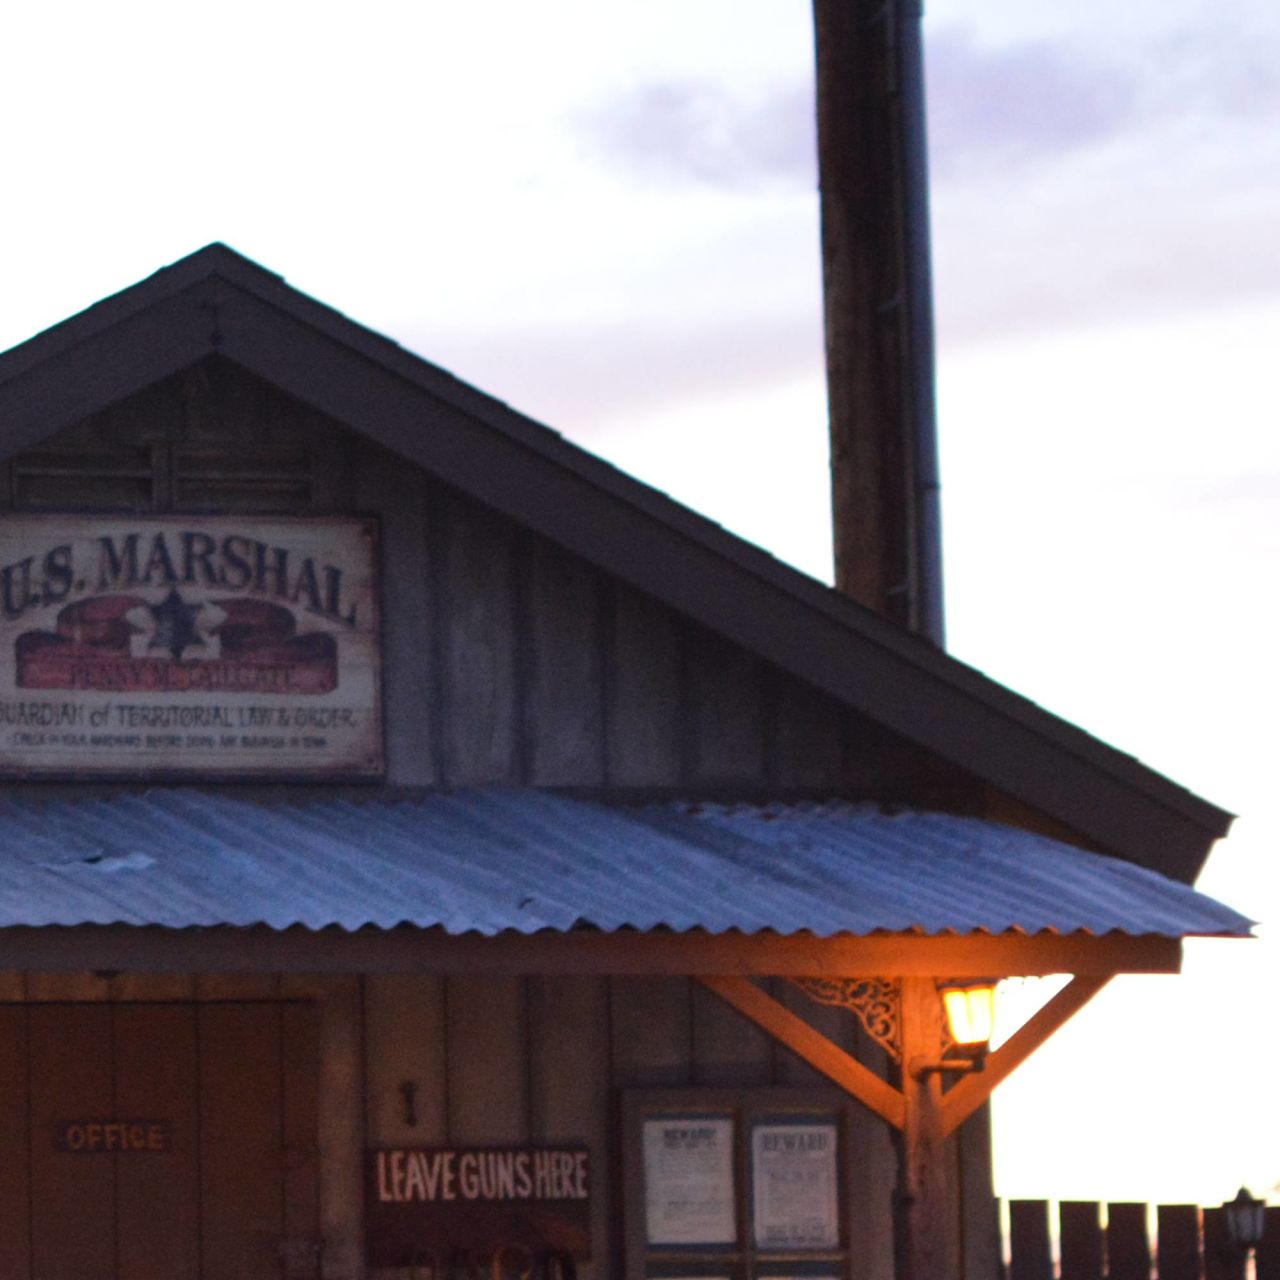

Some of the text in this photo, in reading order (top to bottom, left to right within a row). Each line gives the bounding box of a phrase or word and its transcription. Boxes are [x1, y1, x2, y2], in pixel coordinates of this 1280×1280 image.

[0, 531, 357, 628] U.S. MARSHAL
[90, 701, 111, 727] of
[115, 704, 233, 727] TERRITORIAL
[238, 705, 272, 727] LAW
[278, 706, 290, 727] &
[295, 706, 357, 728] ORDER
[66, 1122, 162, 1150] OFFICE
[761, 1133, 828, 1151] REWARD
[377, 1150, 589, 1201] LEAVE GUNS HERE
